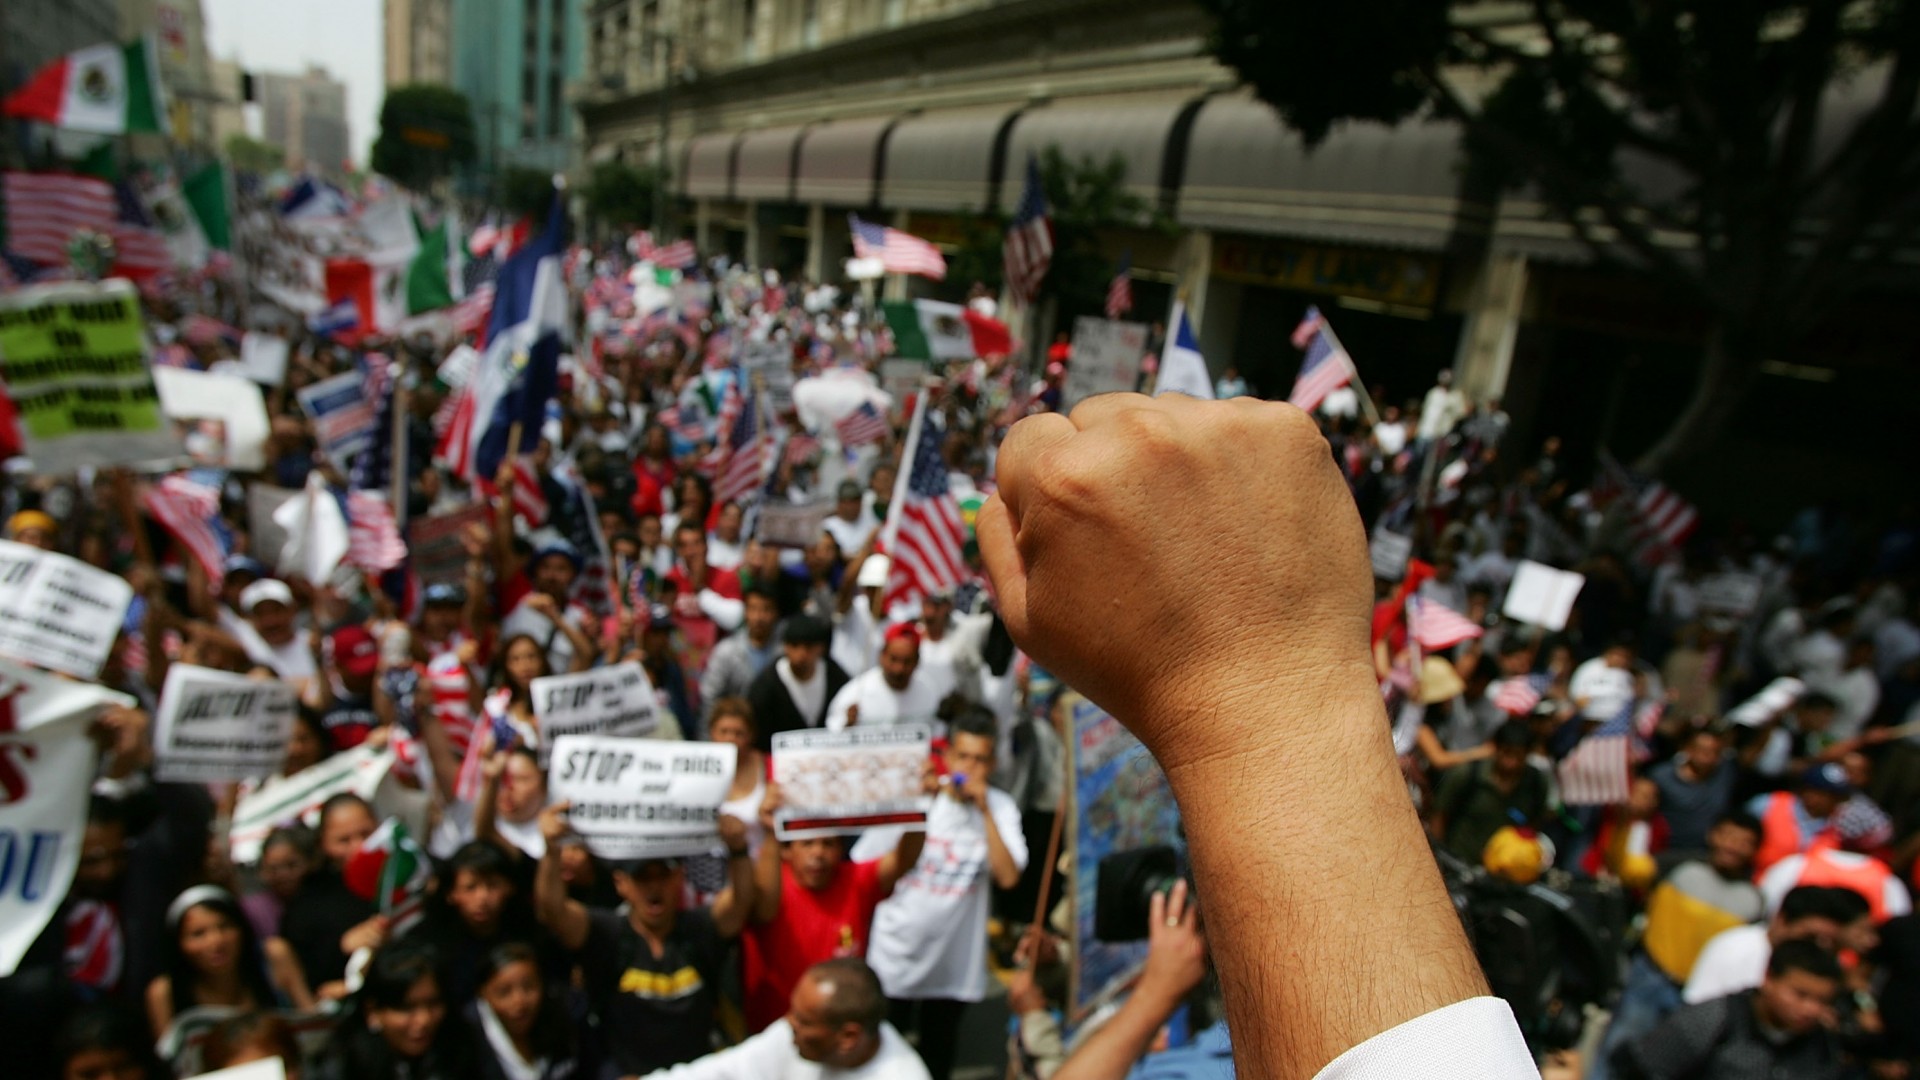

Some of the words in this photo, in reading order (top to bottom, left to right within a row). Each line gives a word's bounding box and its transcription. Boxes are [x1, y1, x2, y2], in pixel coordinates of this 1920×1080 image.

[546, 681, 595, 714] STOP
[560, 749, 635, 783] STOP
[641, 757, 663, 772] the
[672, 755, 723, 776] raids
[640, 779, 671, 795] and
